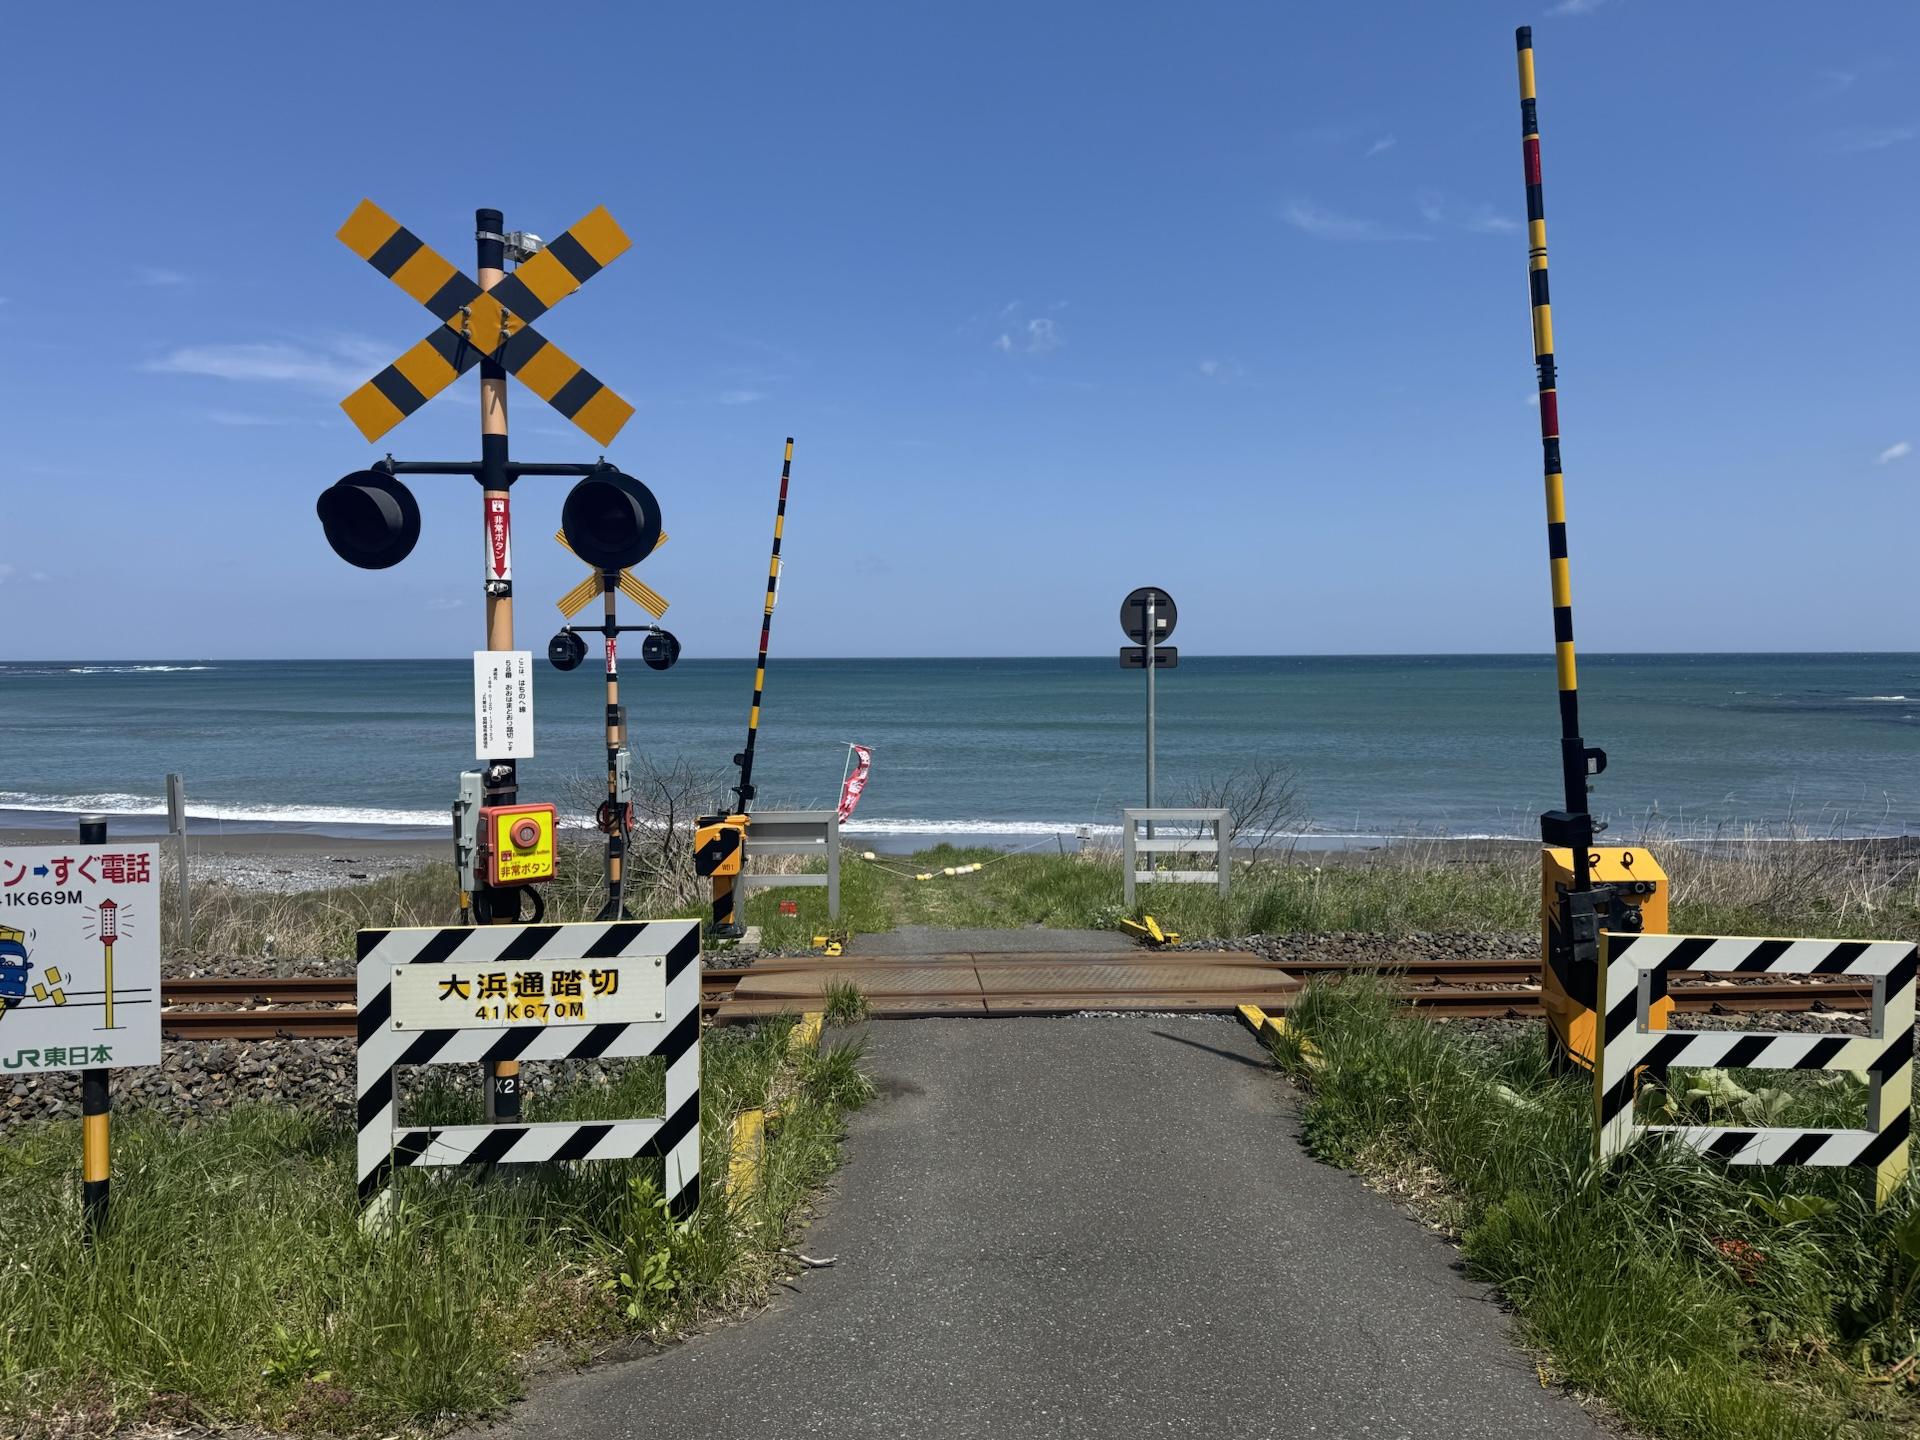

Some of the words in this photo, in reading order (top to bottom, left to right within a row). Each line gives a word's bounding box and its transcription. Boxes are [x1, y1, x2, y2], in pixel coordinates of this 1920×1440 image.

[493, 515, 504, 560] 非常ボタン
[51, 853, 151, 886] すぐ電話
[500, 863, 550, 878] 非常ボタン
[0, 890, 82, 907] 1K669M
[439, 968, 619, 1001] 大浜通踏切
[475, 1002, 584, 1020] 41K670M
[3, 1044, 113, 1069] JR東日本
[495, 1078, 514, 1094] X2
